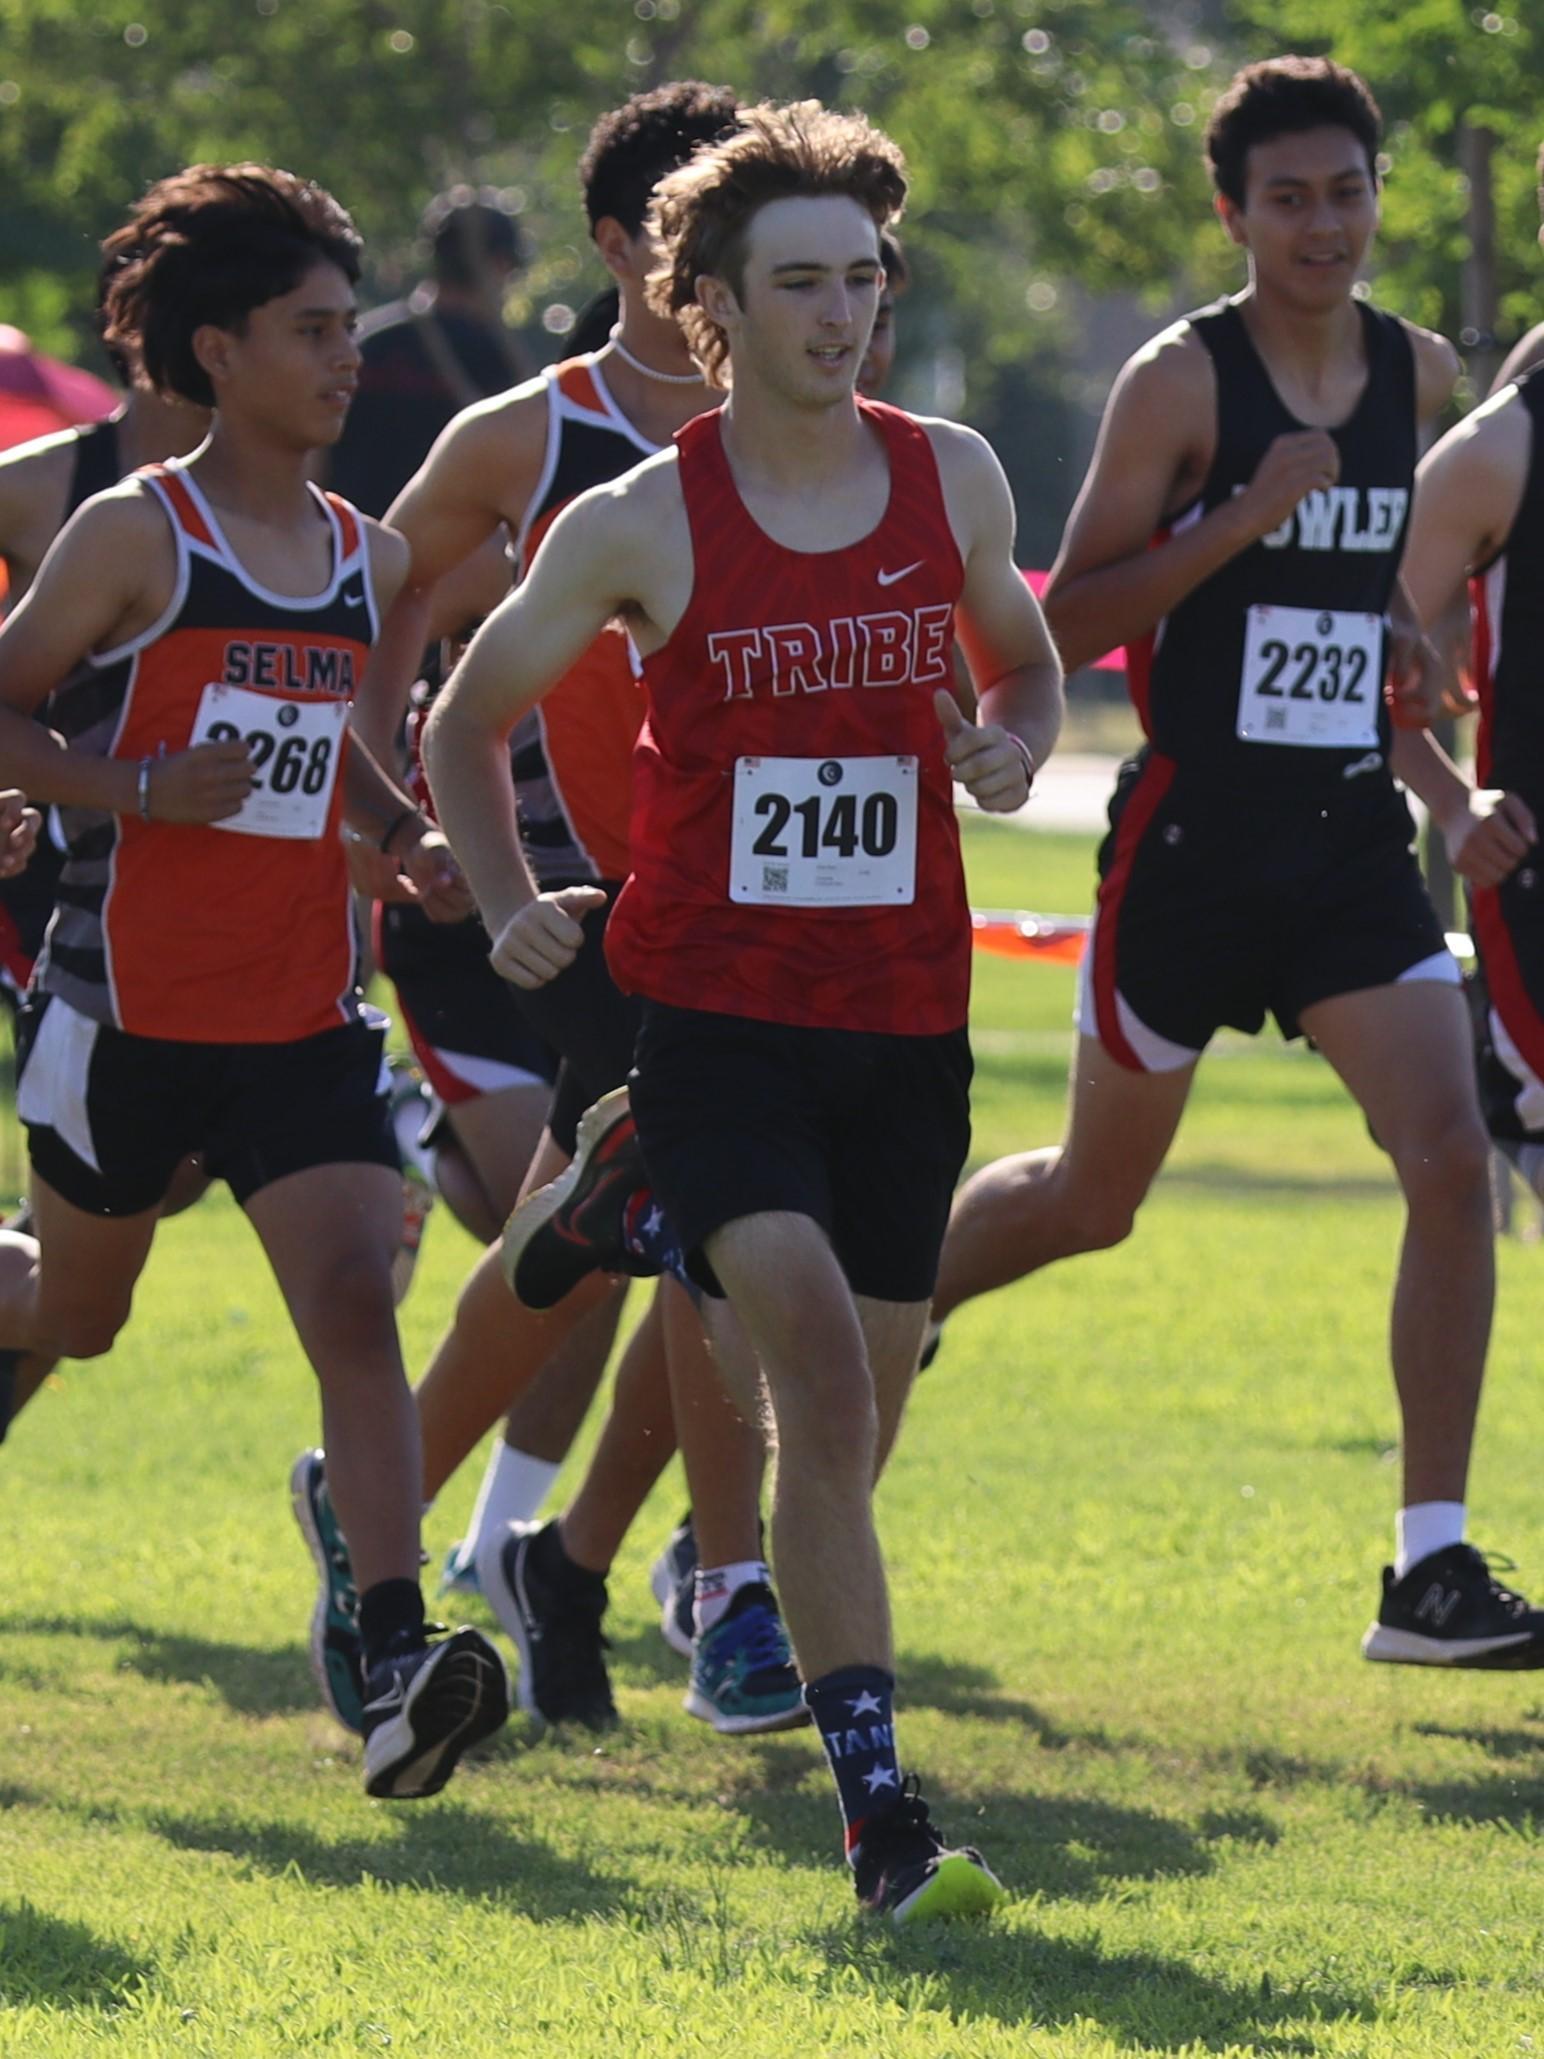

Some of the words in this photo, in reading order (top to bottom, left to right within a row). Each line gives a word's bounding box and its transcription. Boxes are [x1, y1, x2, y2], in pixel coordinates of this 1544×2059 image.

[1233, 486, 1408, 549] WLE
[224, 640, 354, 695] SELMA
[706, 604, 952, 701] TRIBE
[1256, 638, 1367, 703] 2232
[752, 791, 898, 858] 2140
